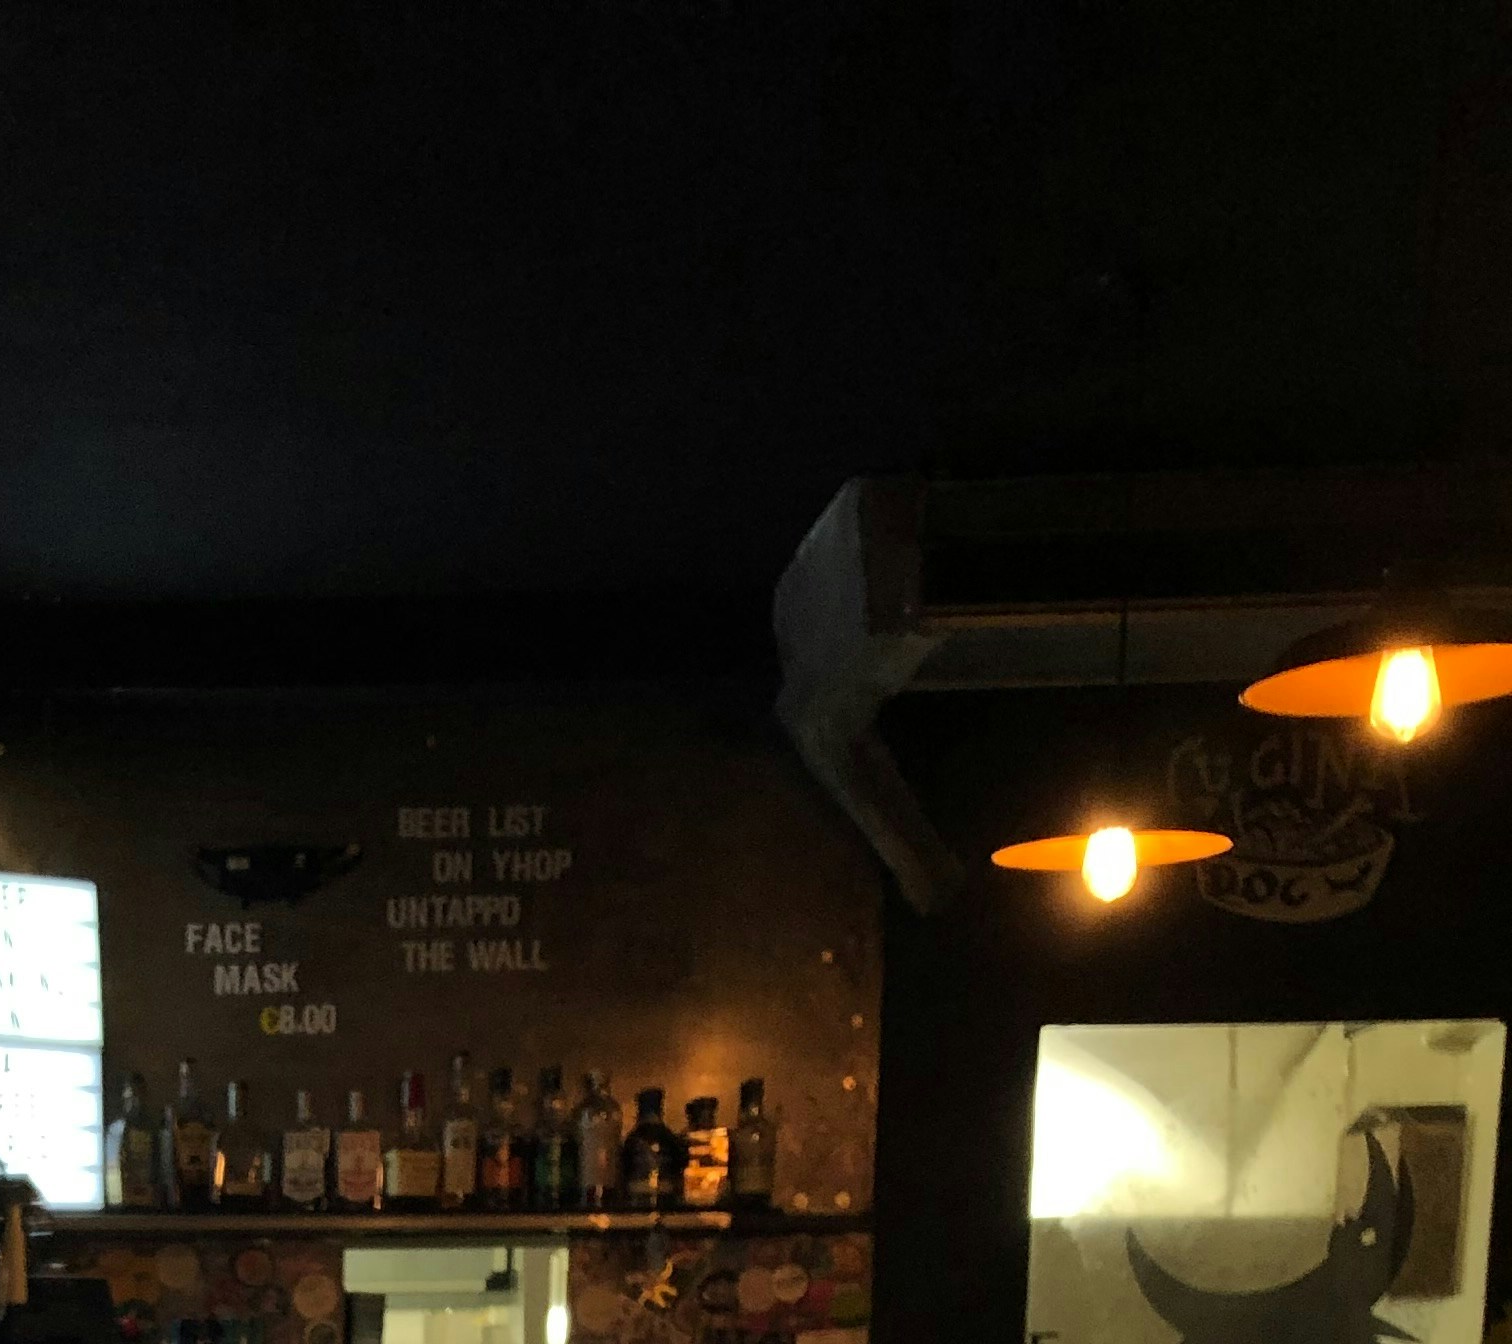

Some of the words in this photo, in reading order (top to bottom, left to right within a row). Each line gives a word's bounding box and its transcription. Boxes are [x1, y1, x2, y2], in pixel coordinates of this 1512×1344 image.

[398, 806, 470, 838] BEER
[489, 805, 545, 837] LIST
[433, 850, 473, 883] ON
[492, 847, 572, 882] YHOP
[386, 895, 522, 928] UNTAPPD
[185, 922, 262, 954] FACE
[402, 940, 455, 972] THE
[467, 939, 548, 972] WALL
[213, 961, 299, 996] MASK
